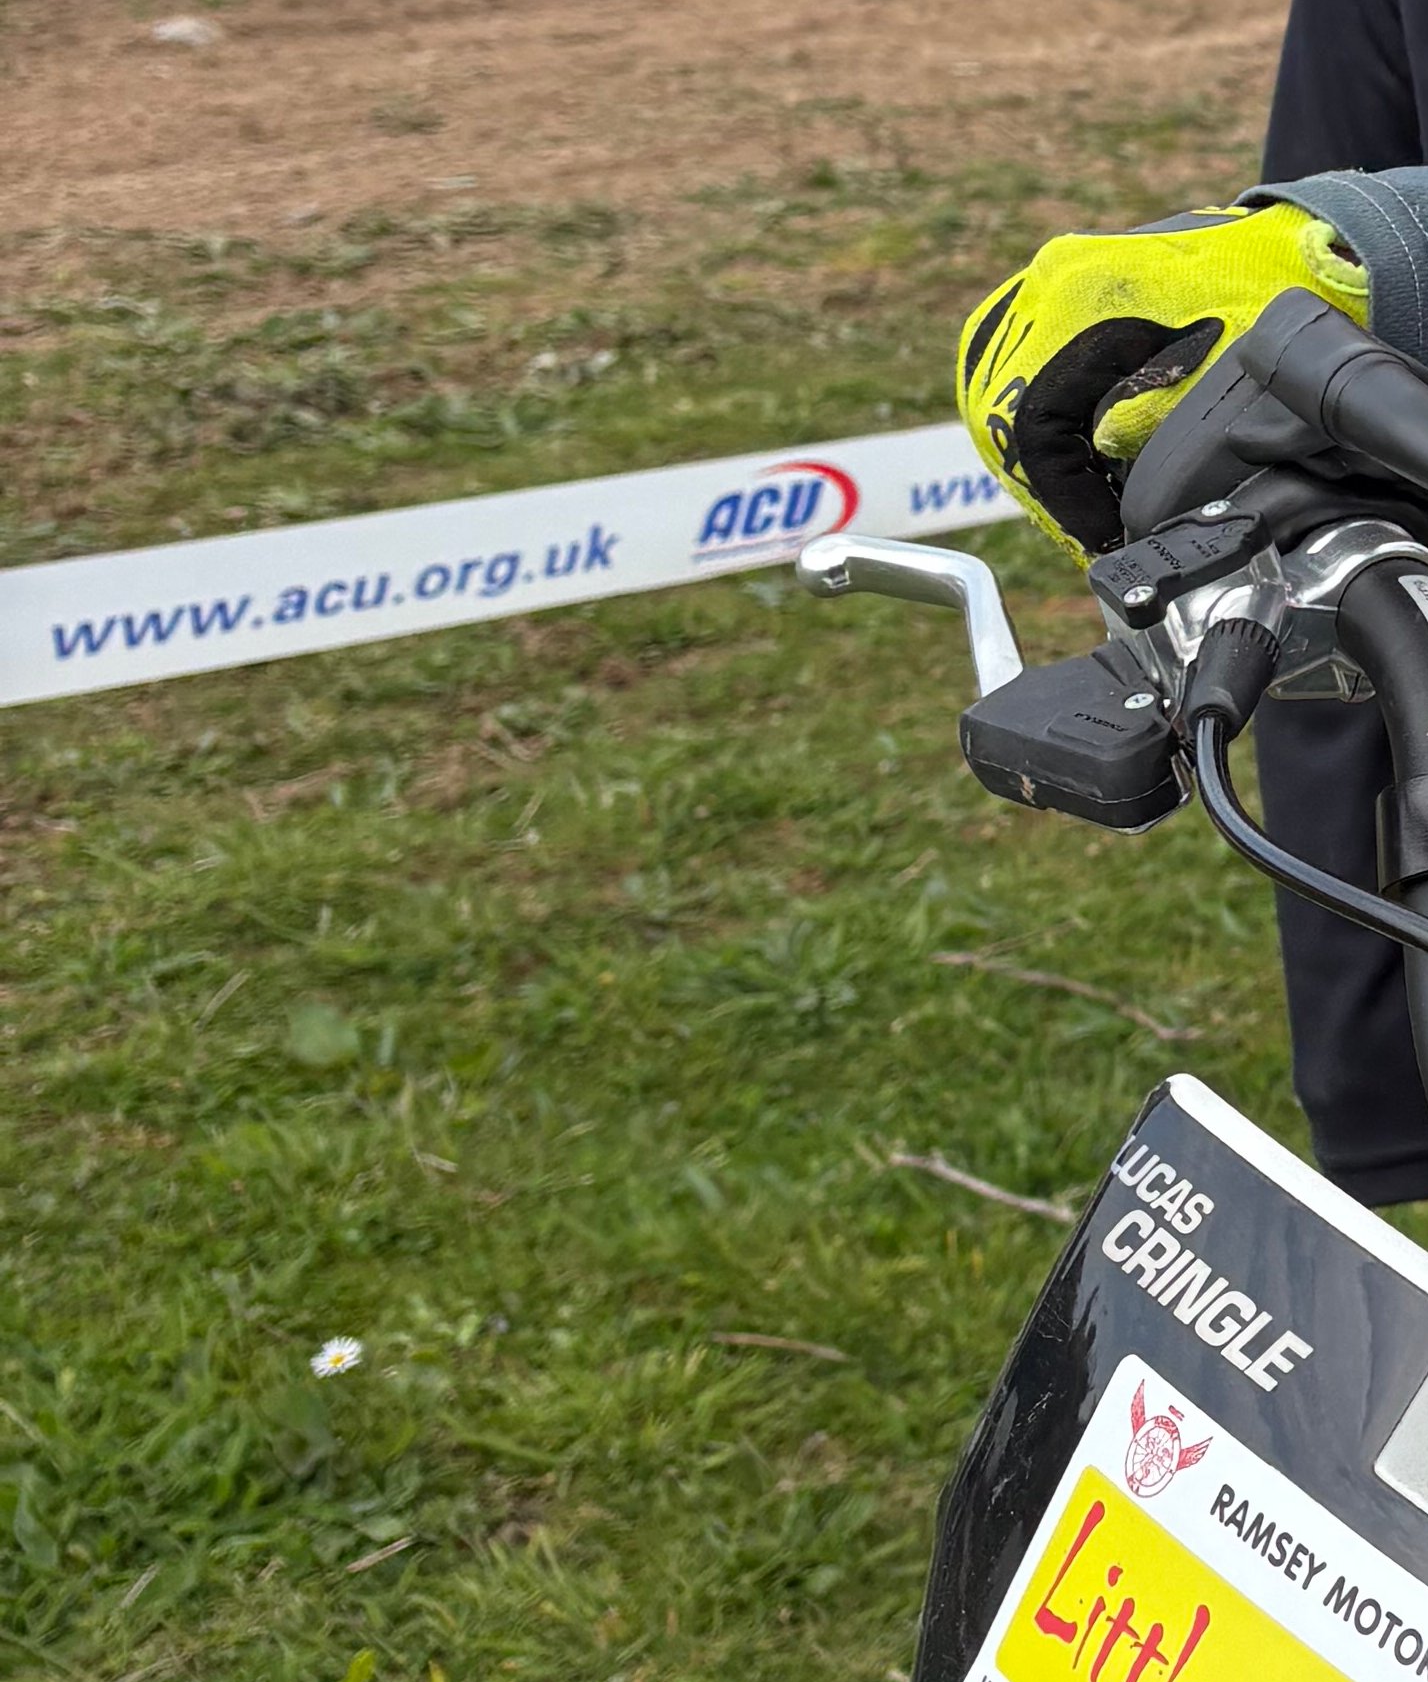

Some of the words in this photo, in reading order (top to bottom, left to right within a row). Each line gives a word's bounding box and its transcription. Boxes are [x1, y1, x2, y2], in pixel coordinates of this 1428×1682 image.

[698, 477, 827, 545] ACU
[51, 524, 618, 660] www.acu.org.uk
[1111, 1133, 1215, 1235] LUCAS
[1101, 1208, 1314, 1392] CRINGLE
[1209, 1483, 1322, 1592] RAMSEY
